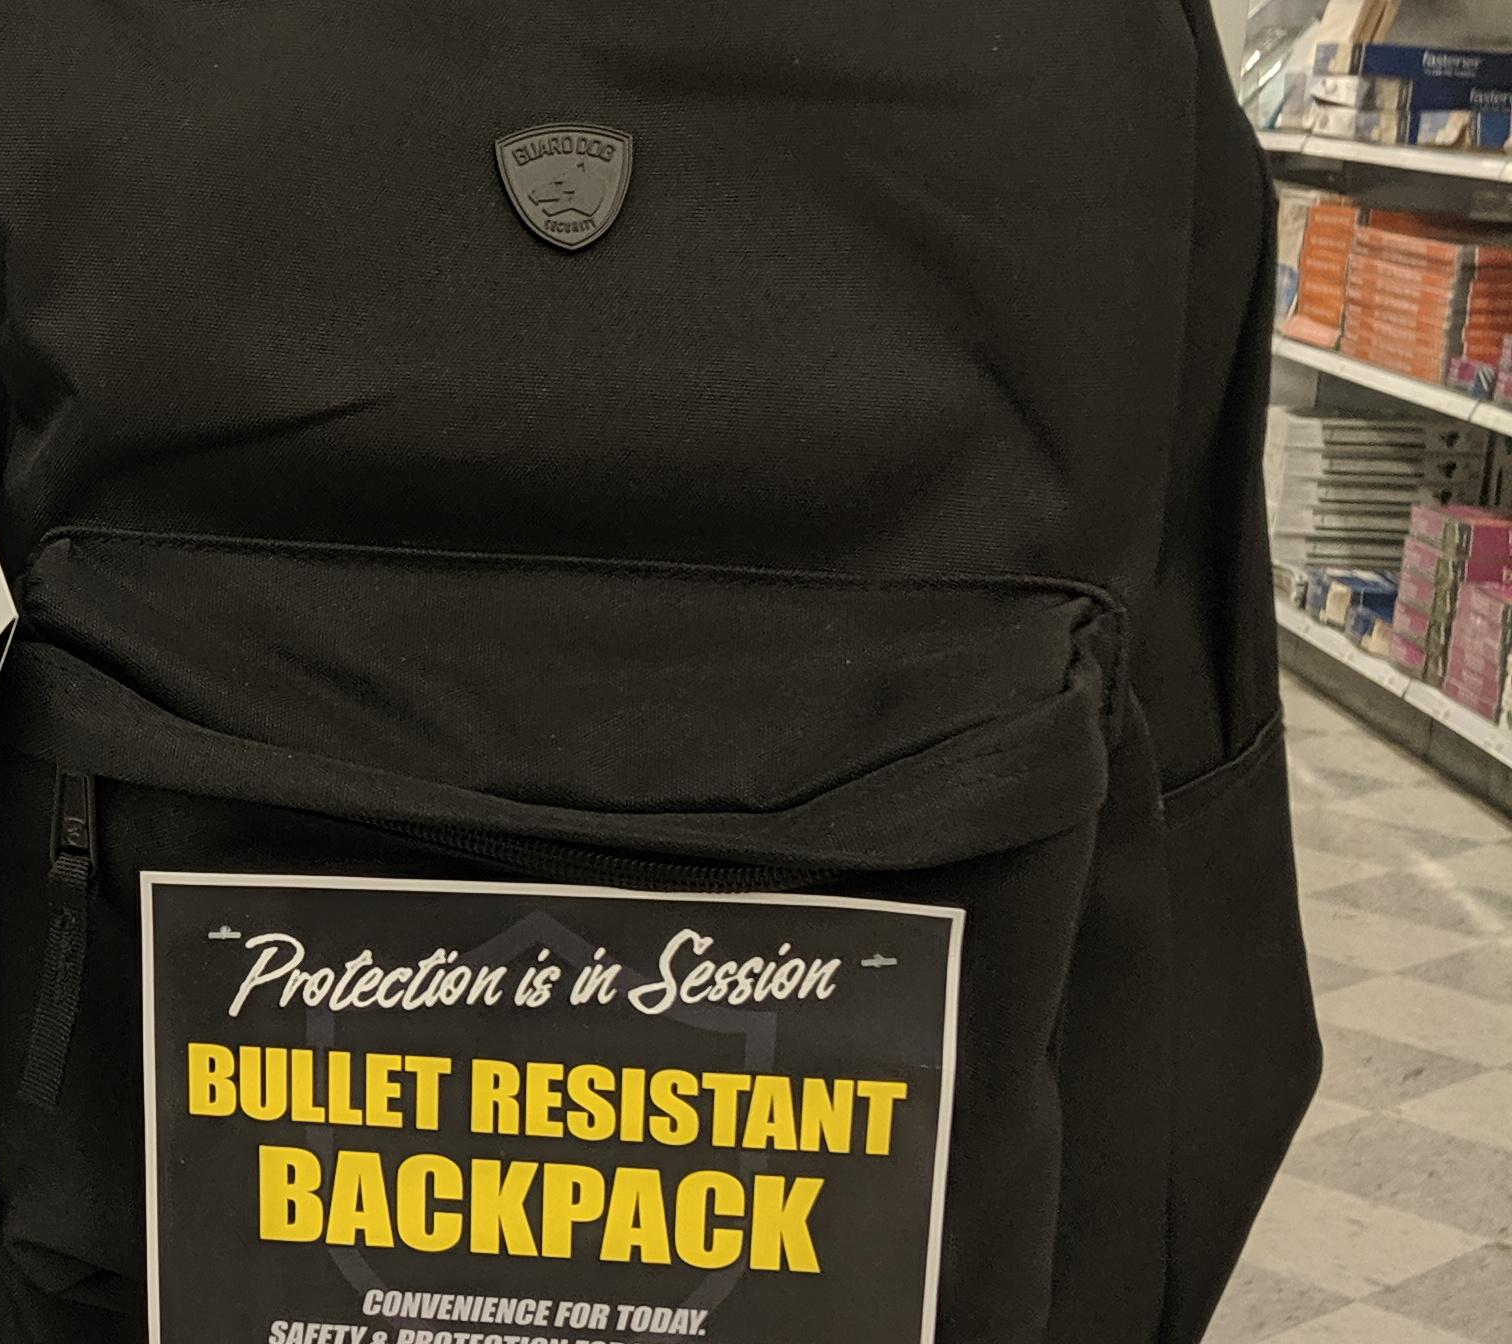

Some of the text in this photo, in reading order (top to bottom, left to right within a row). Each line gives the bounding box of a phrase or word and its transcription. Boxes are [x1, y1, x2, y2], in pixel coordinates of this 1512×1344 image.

[512, 136, 615, 166] GUARD DOG
[228, 928, 838, 1018] Protection is in Session
[187, 1042, 907, 1157] BULLET RESISTANT
[258, 1144, 824, 1274] BACKPACK
[362, 1288, 708, 1335] CONVENIENCE FOR TODAY.
